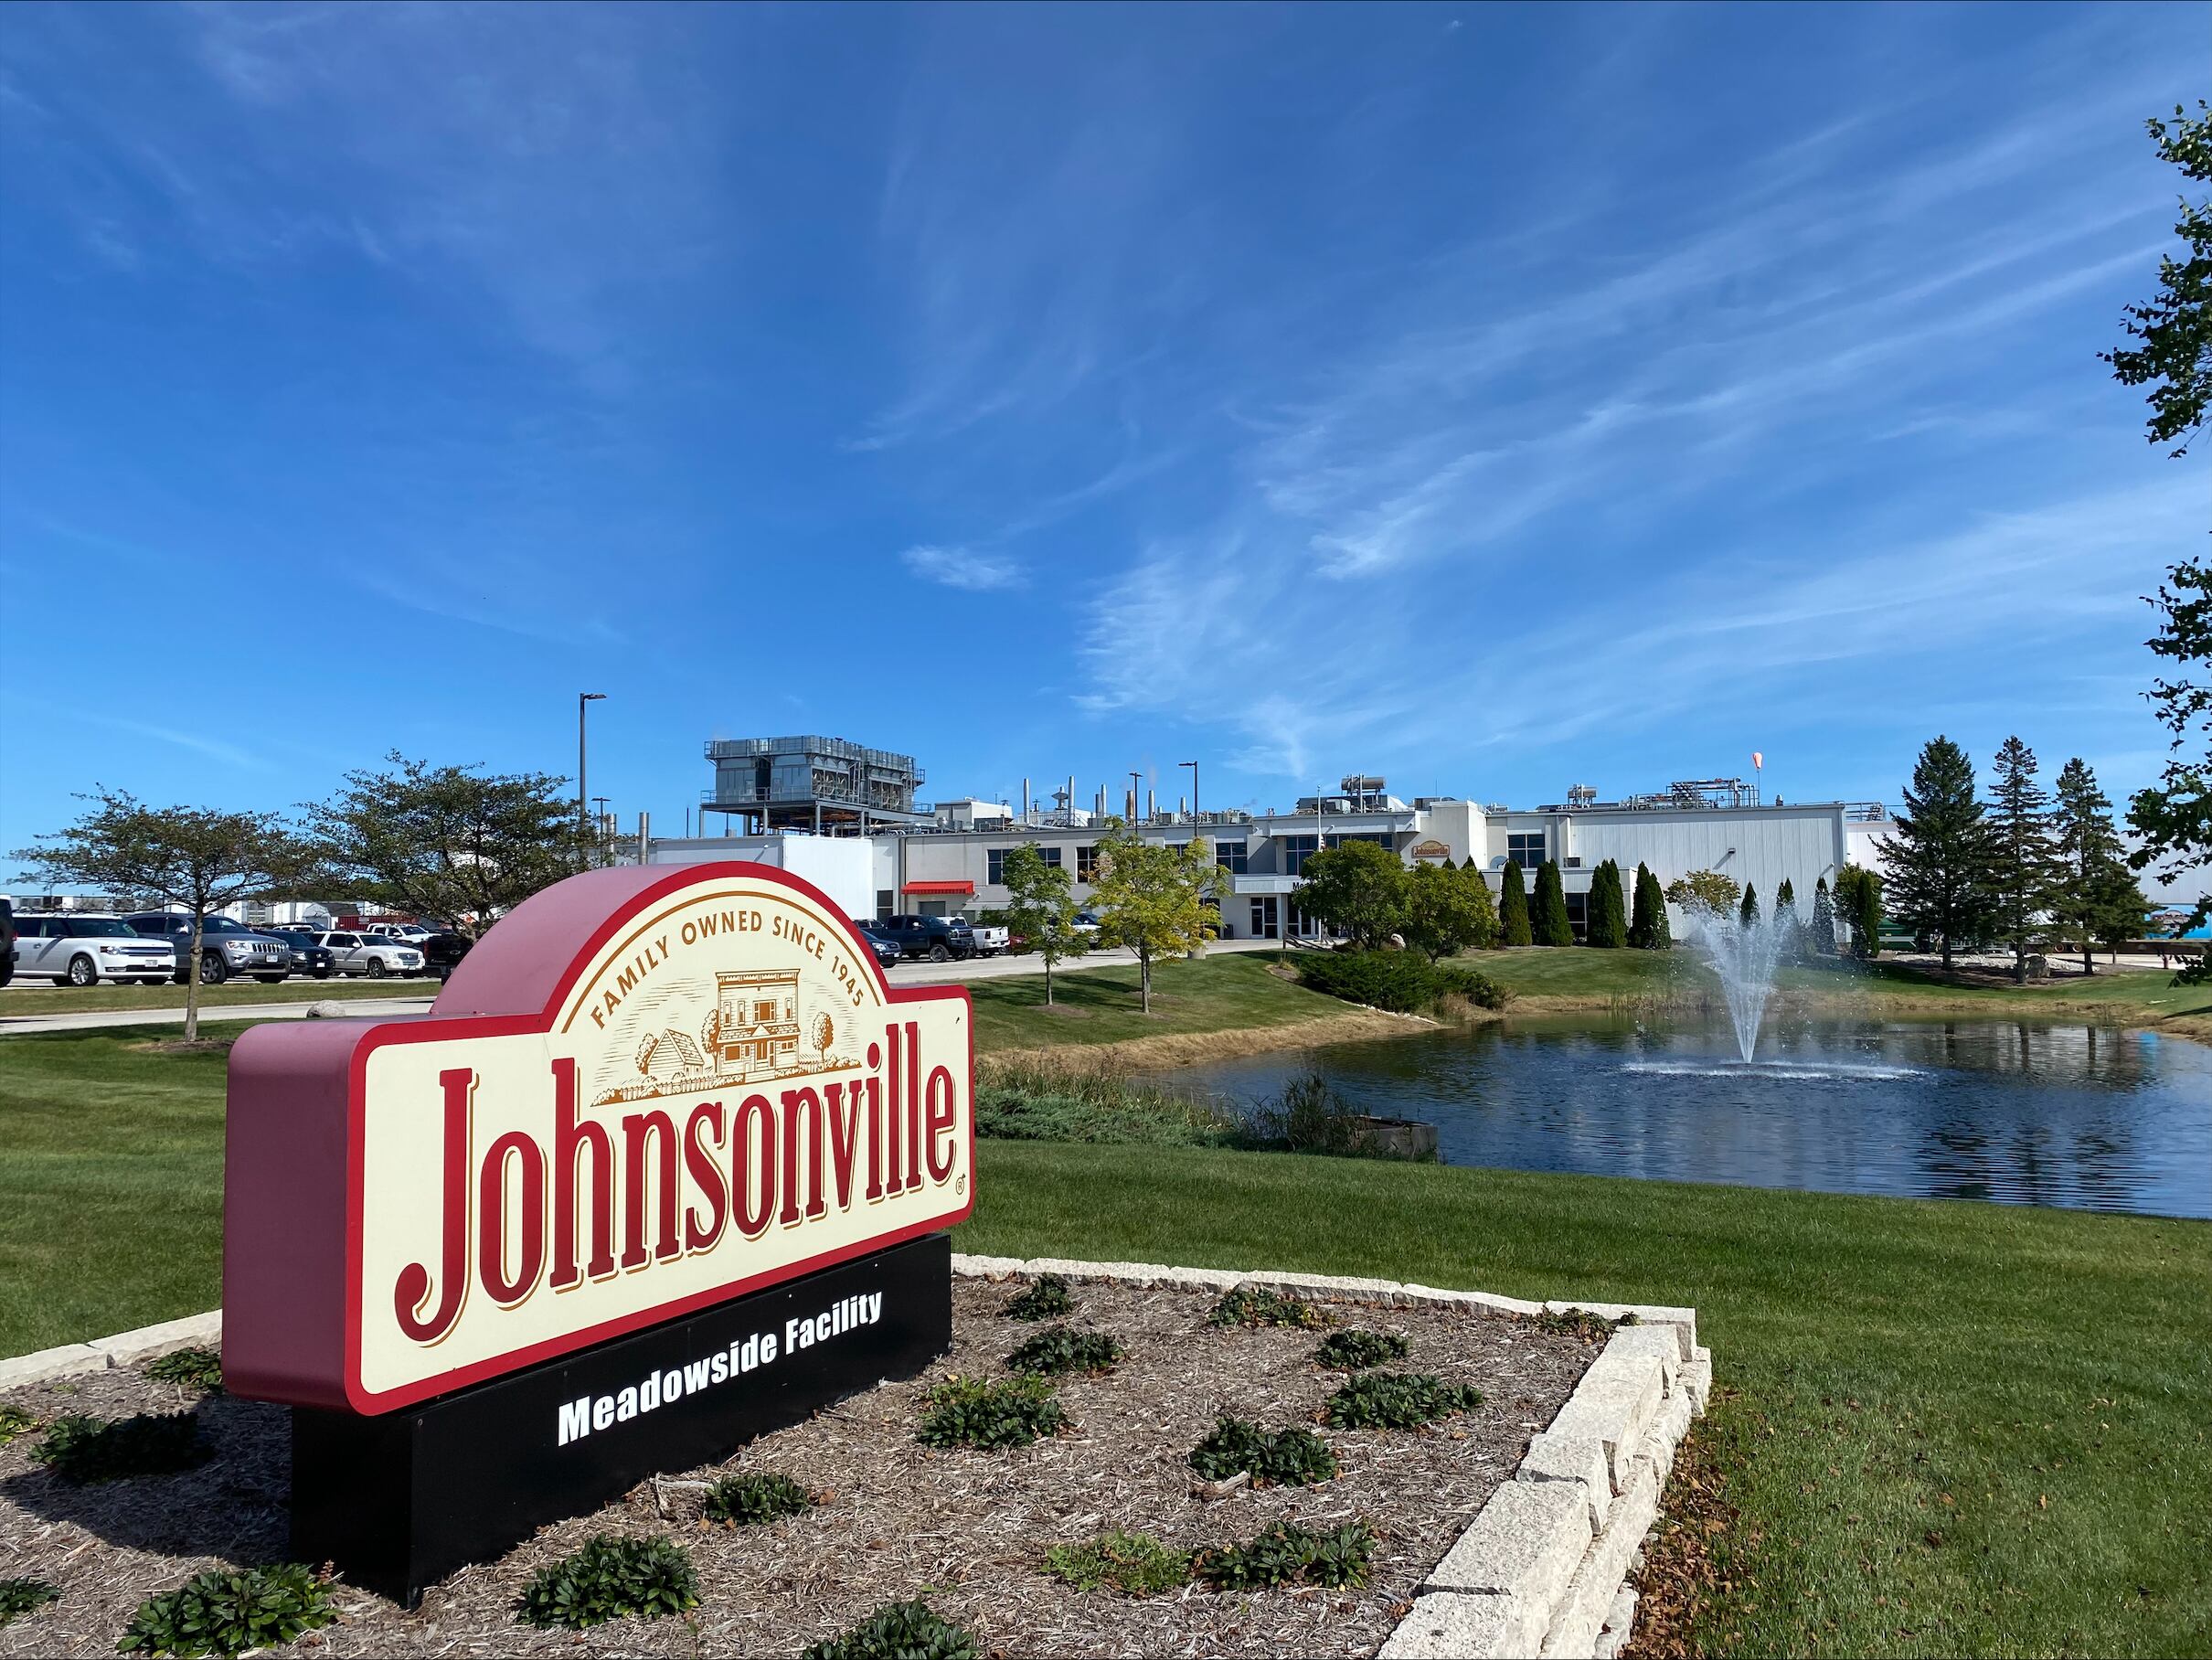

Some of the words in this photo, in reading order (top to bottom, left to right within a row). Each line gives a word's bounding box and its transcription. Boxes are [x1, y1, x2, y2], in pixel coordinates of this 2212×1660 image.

[590, 935, 670, 1029] FAMILY
[681, 910, 763, 947] OWNED
[772, 916, 825, 960] SINCE
[830, 954, 866, 1008] 1945
[394, 1021, 957, 1348] Johnsonville
[558, 1332, 778, 1447] Meadowside
[785, 1291, 883, 1355] Facility
